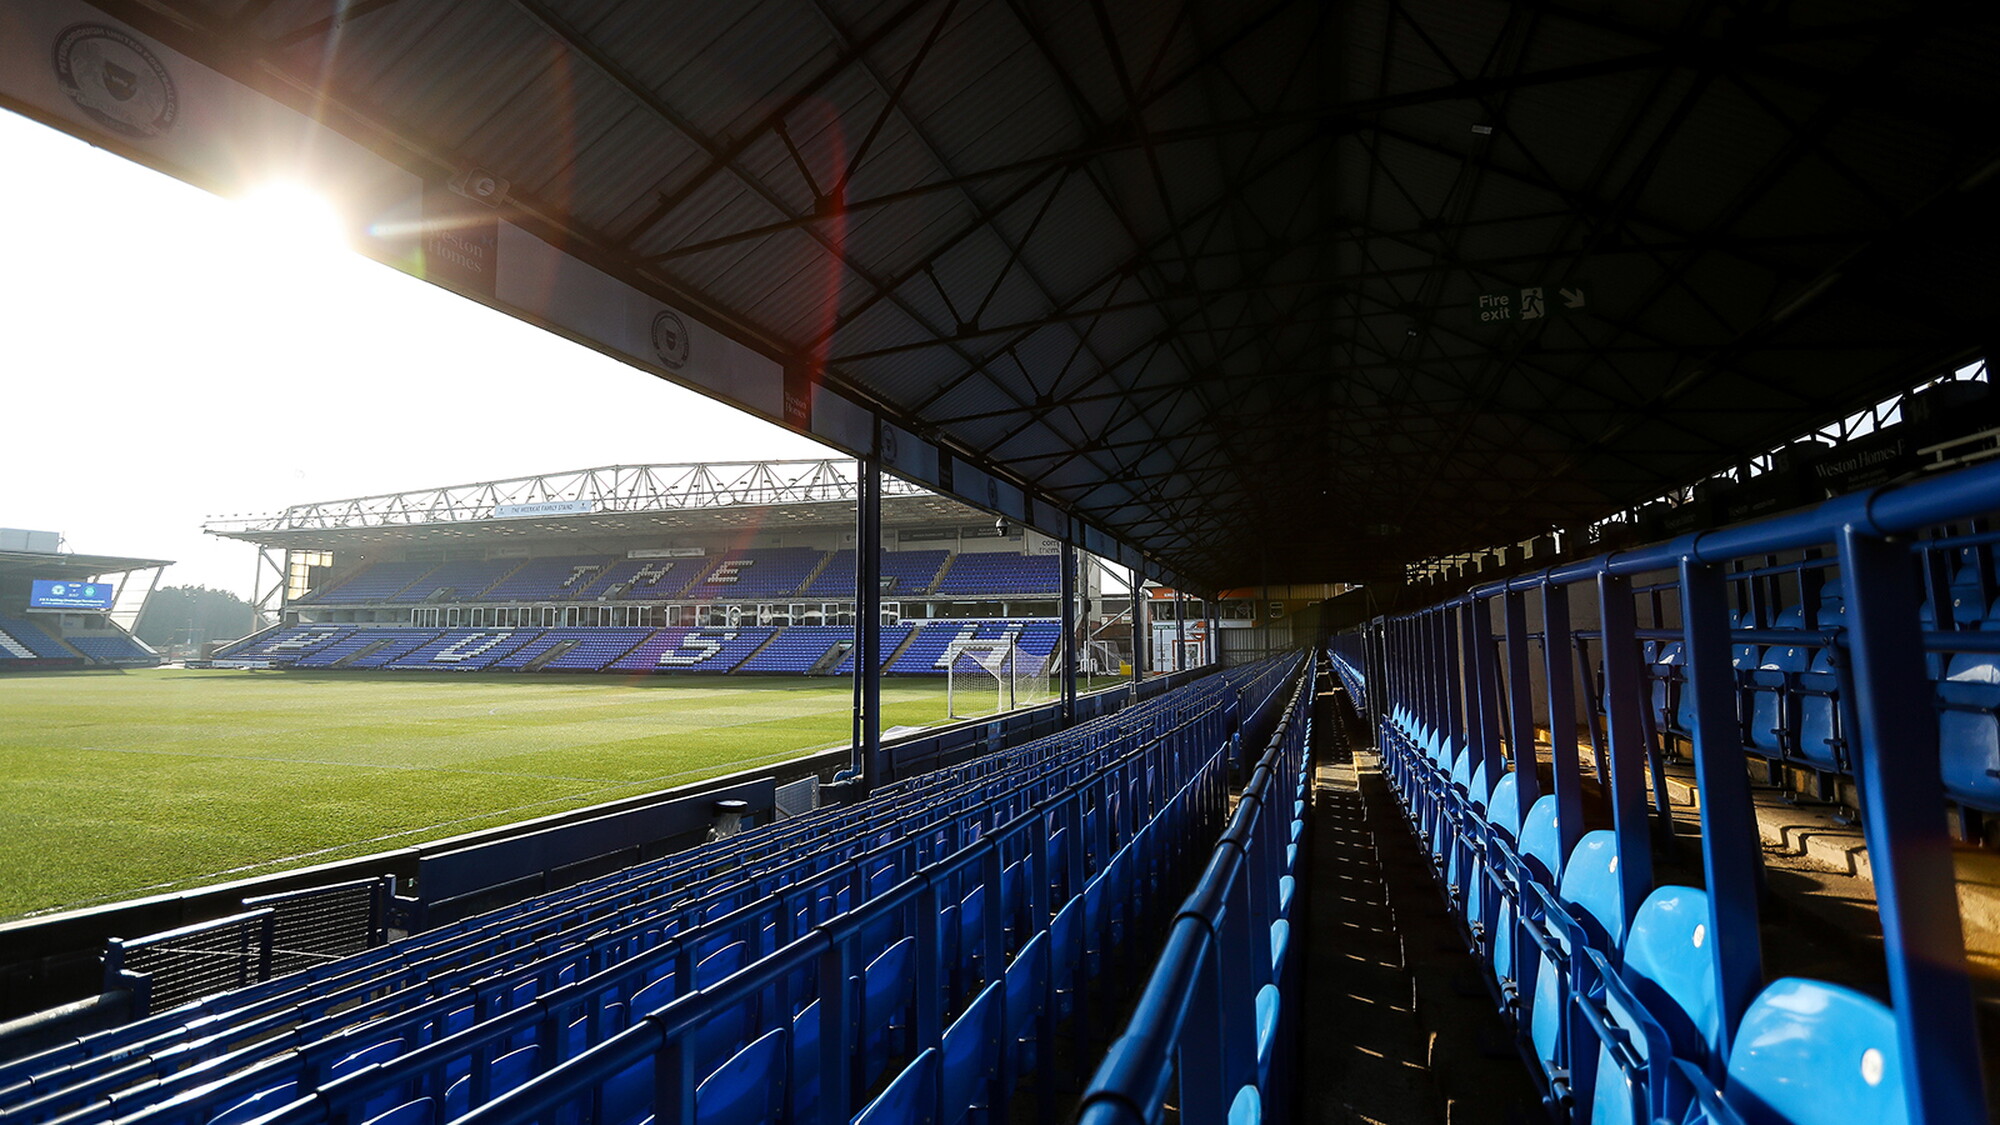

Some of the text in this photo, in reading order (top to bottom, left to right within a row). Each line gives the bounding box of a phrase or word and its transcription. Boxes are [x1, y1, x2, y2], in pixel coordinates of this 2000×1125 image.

[428, 237, 482, 273] Homes
[1479, 294, 1510, 308] Fire
[1480, 307, 1511, 322] exit
[1815, 459, 1858, 478] Weston
[1858, 448, 1897, 469] Homes
